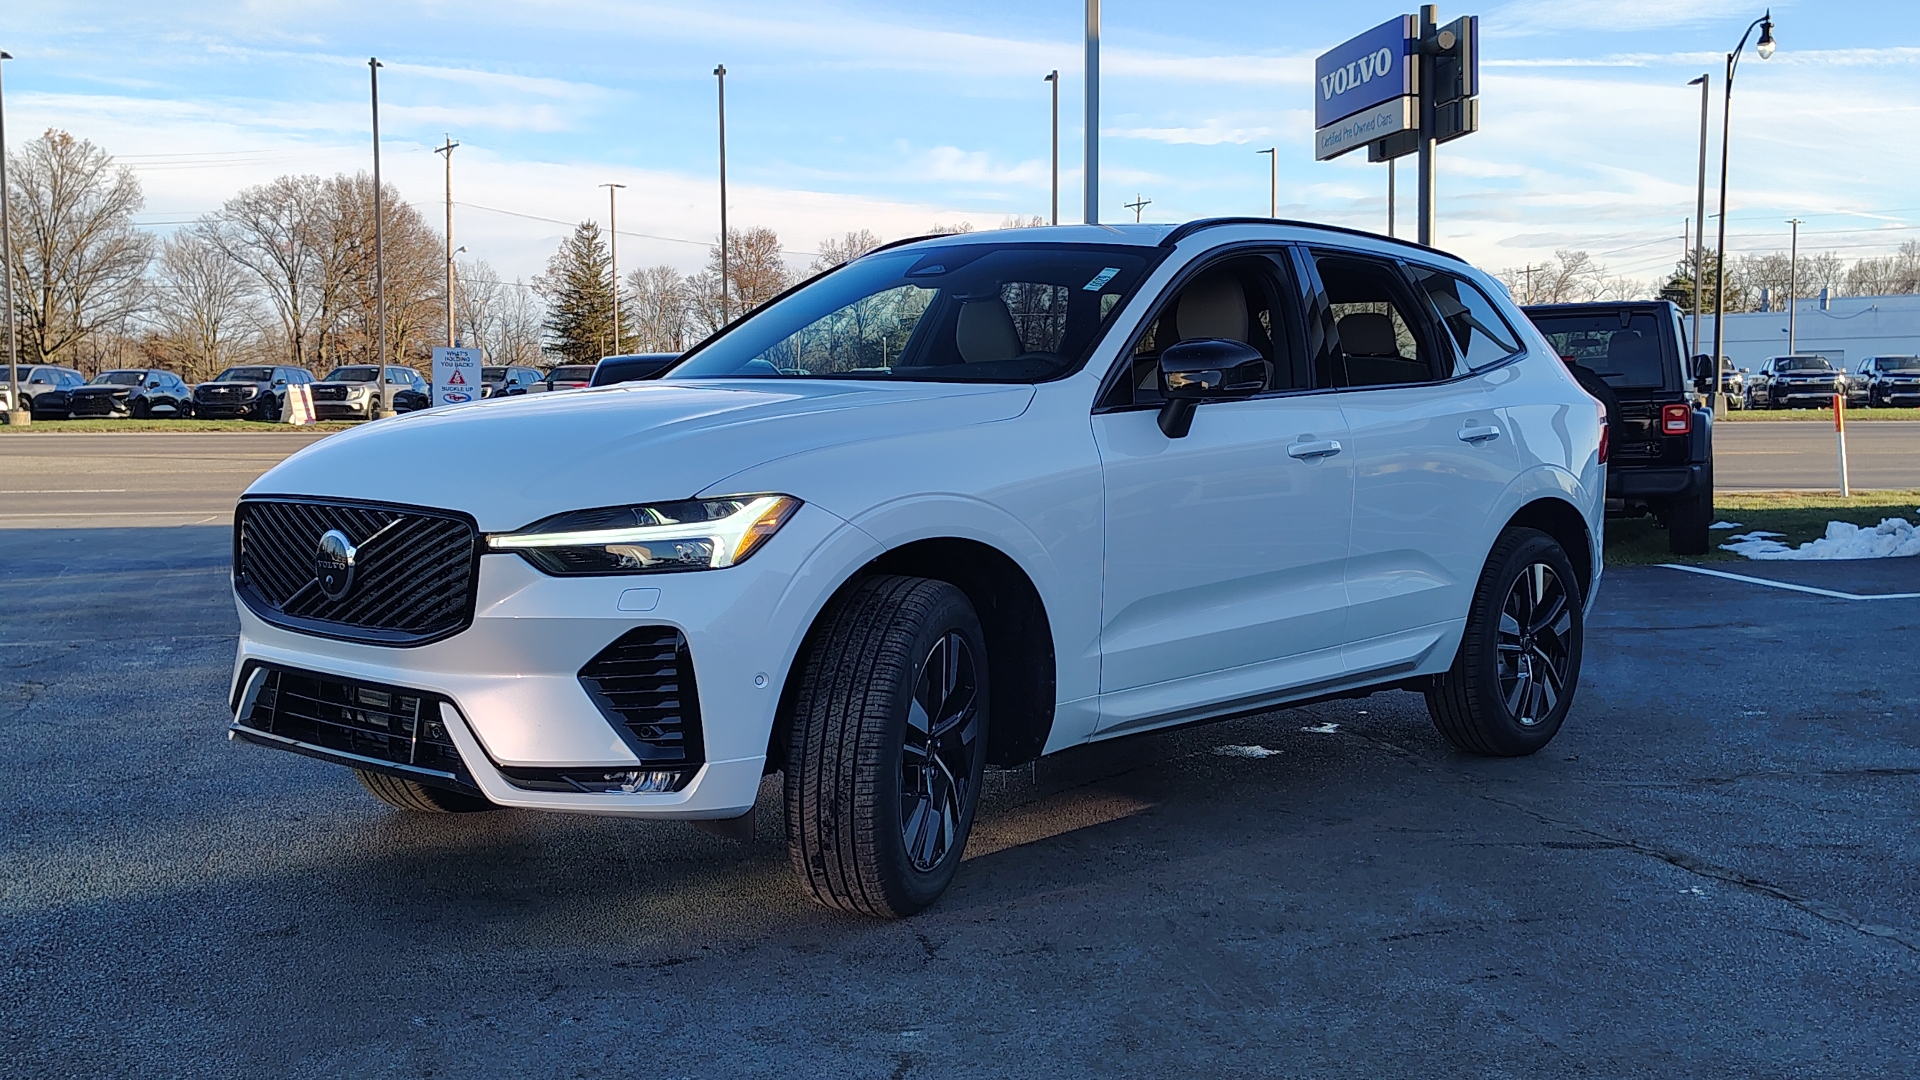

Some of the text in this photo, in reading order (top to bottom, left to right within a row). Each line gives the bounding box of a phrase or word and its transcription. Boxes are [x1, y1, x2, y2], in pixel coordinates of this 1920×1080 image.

[1320, 47, 1392, 100] VOLVO
[1352, 116, 1376, 137] Owned
[1376, 112, 1393, 128] Cars
[317, 560, 346, 570] VOLVO
